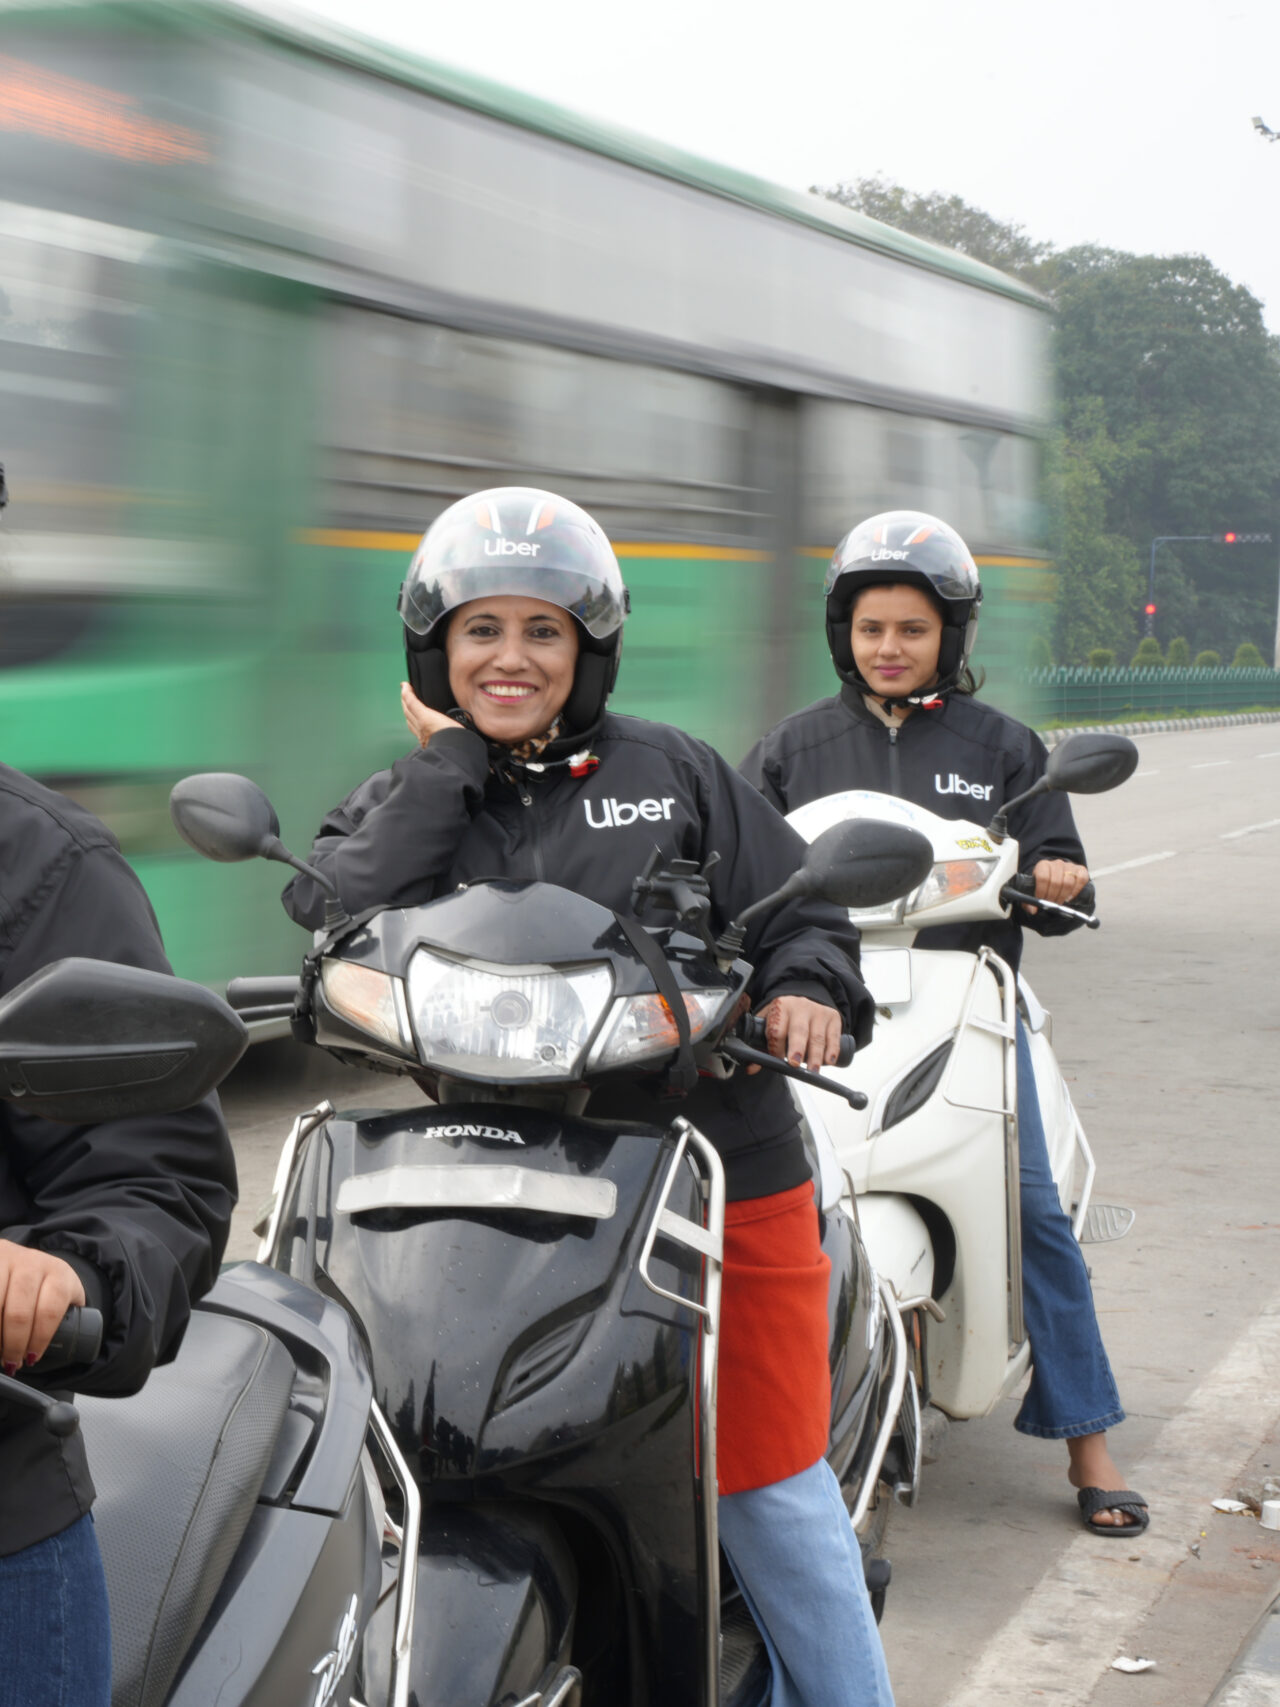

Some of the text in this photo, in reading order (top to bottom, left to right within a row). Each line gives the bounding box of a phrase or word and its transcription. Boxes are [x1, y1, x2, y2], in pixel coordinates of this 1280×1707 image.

[484, 539, 540, 557] Uber
[871, 548, 909, 561] Uber
[934, 773, 994, 801] Uber
[584, 797, 675, 829] Uber
[423, 1124, 526, 1145] HONDA
